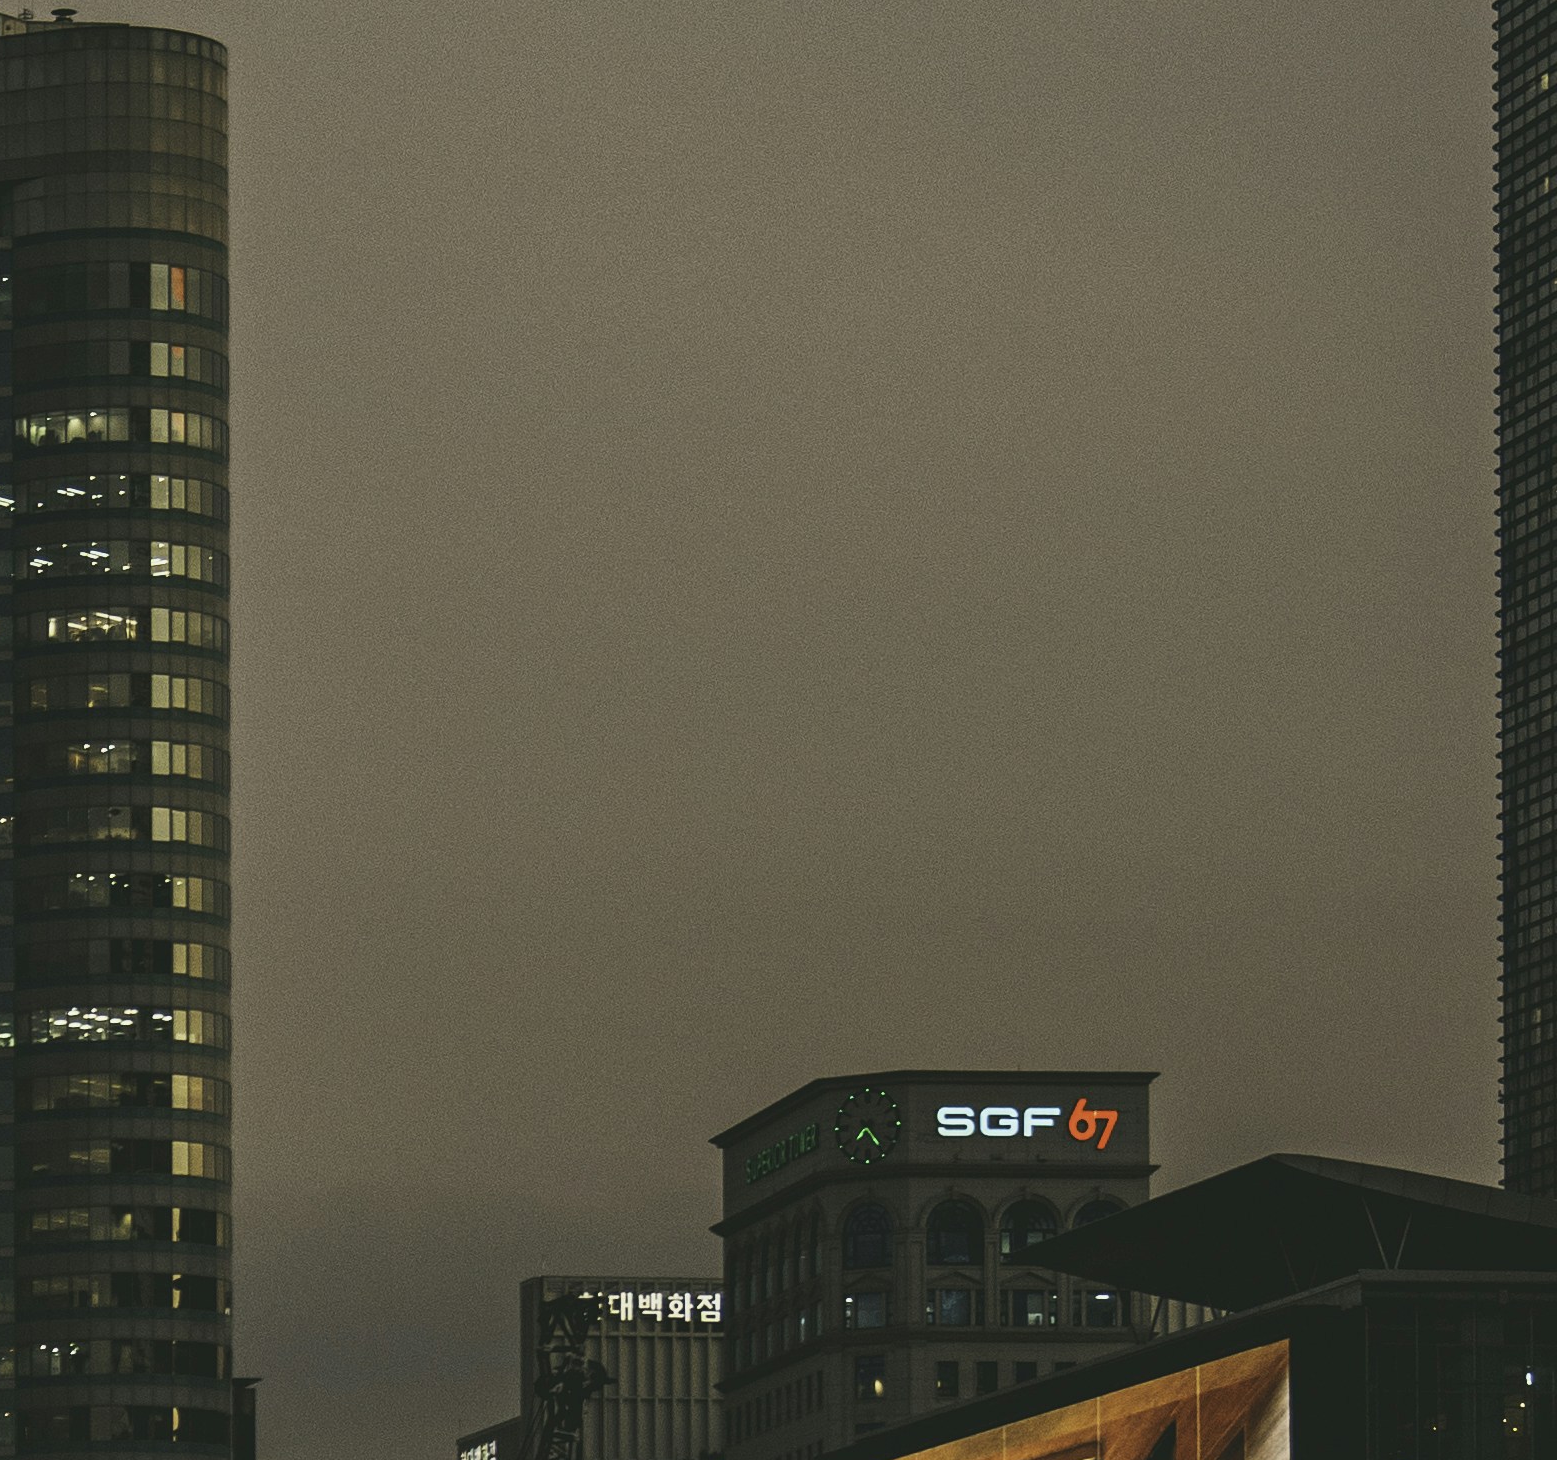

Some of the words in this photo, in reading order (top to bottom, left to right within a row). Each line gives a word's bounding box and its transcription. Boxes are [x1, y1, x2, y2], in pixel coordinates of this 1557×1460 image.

[937, 1105, 1061, 1138] SGF
[1067, 1097, 1118, 1150] 67
[746, 1140, 787, 1184] SUPERIOR
[789, 1123, 817, 1160] TOWER
